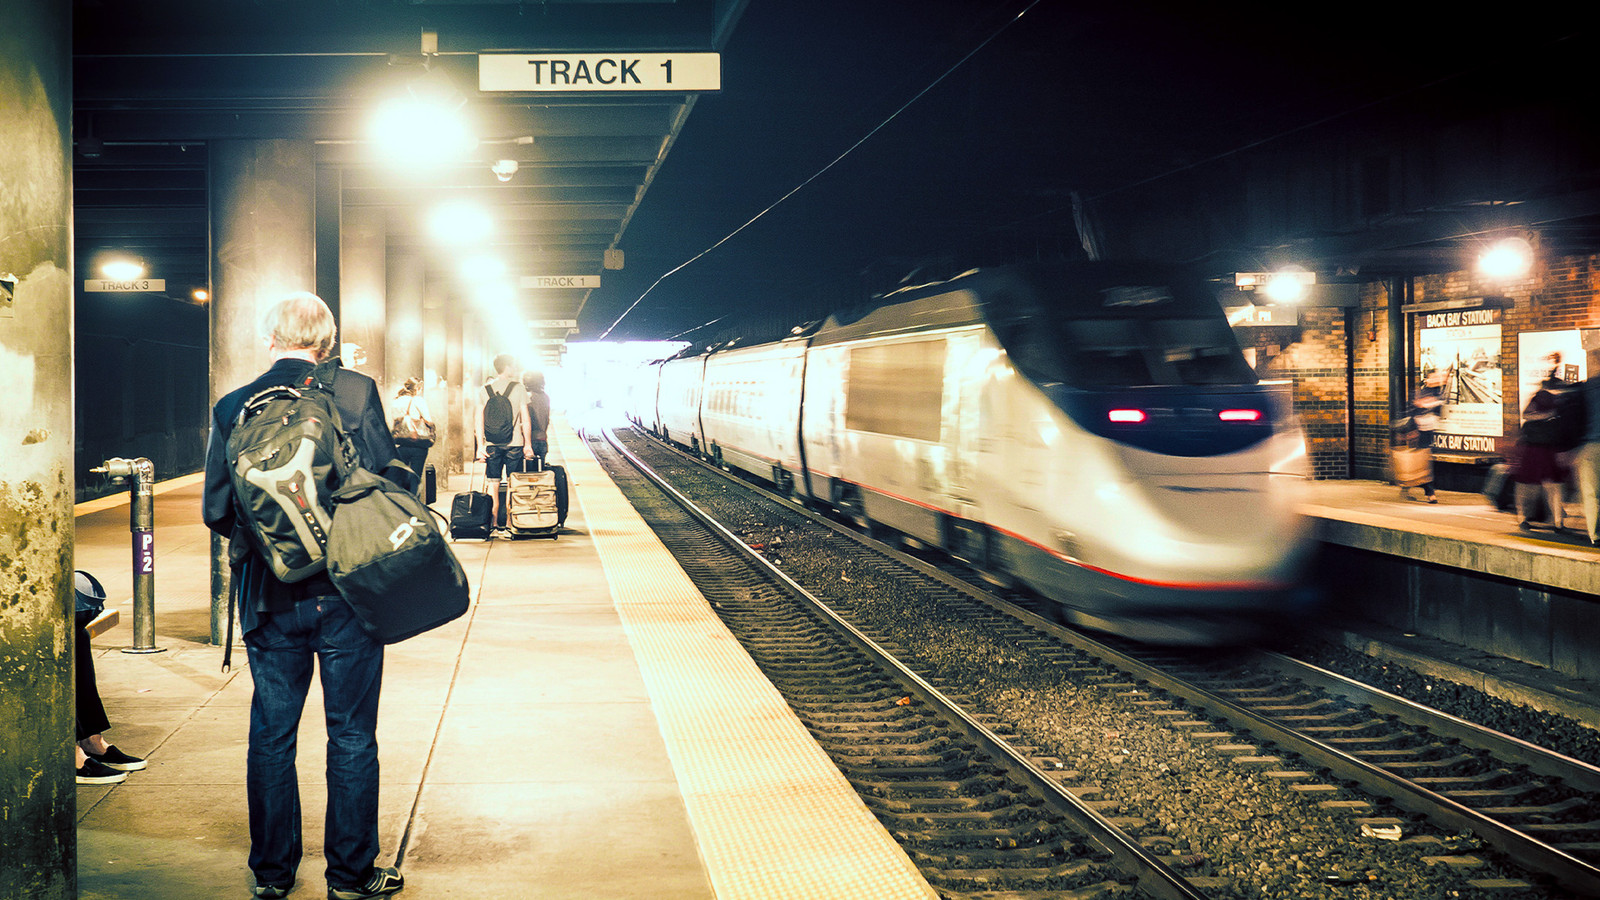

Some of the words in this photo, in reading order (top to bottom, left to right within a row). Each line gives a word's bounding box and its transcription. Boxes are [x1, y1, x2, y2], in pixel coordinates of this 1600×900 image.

[528, 59, 642, 85] TRACK
[660, 59, 673, 84] 1
[100, 280, 139, 291] TRACK
[142, 280, 149, 290] 3
[537, 277, 575, 287] TRACK
[580, 277, 586, 286] 1
[1426, 313, 1447, 328] BACK
[1447, 312, 1461, 326] BAY
[1462, 309, 1494, 325] STATION
[1433, 434, 1448, 448] ACK
[1448, 435, 1463, 450] BAY
[1463, 436, 1495, 452] STATION
[142, 534, 153, 572] P-2
